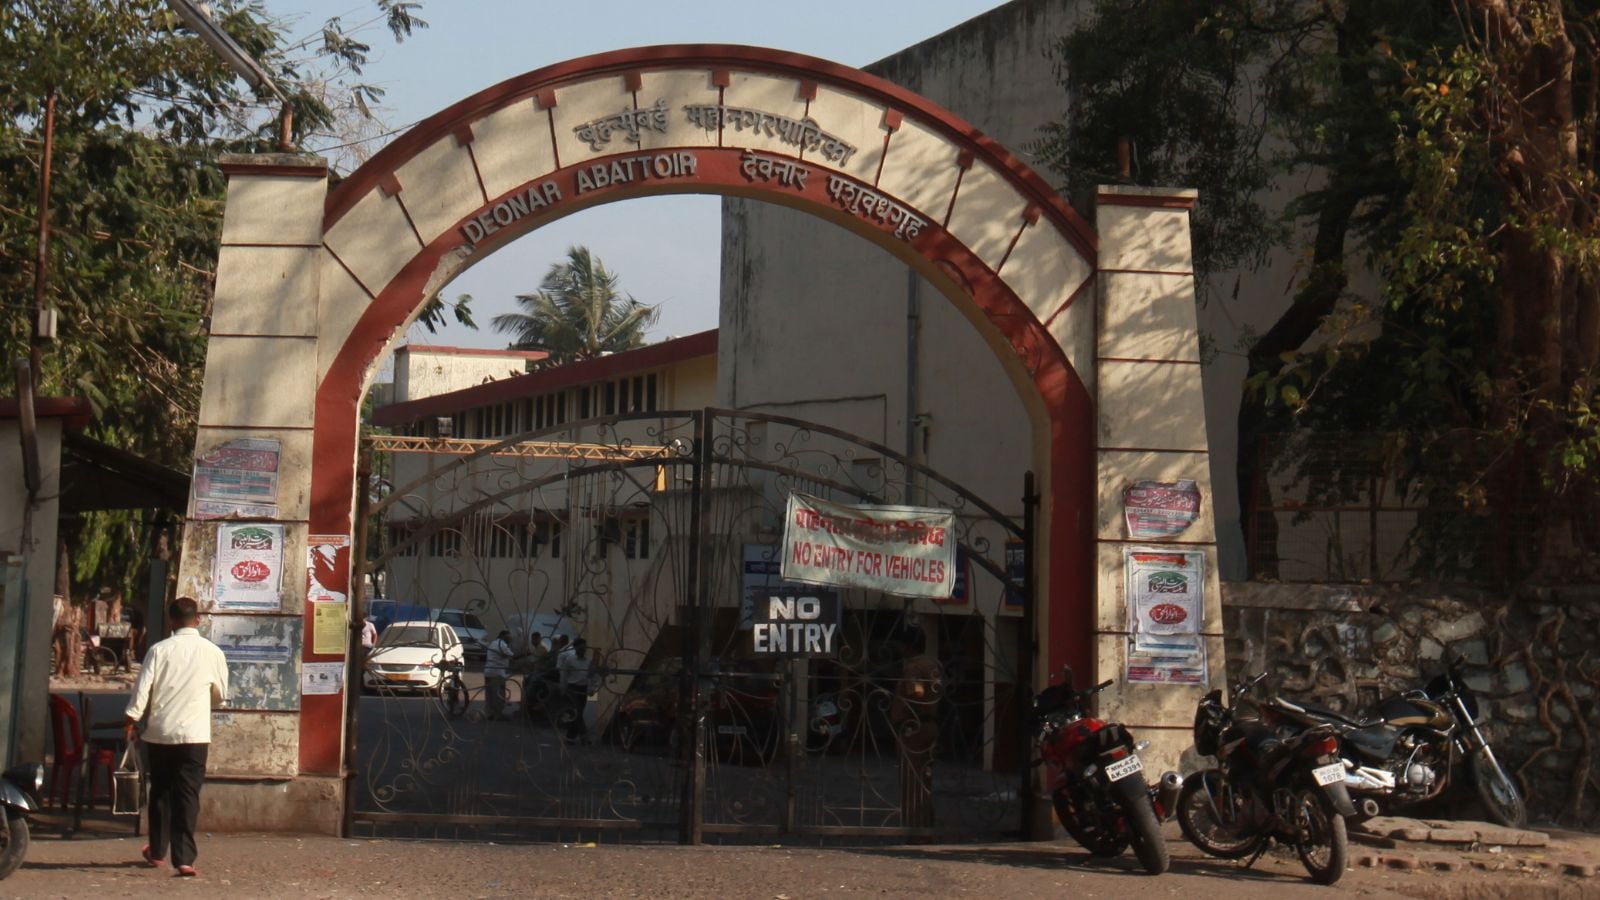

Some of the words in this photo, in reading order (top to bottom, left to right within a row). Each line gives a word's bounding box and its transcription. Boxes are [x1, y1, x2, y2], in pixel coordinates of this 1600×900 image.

[683, 103, 858, 166] महानगरपालिका
[462, 180, 562, 245] DEONAR
[576, 152, 697, 195] ABATTOIR
[740, 149, 810, 189] देवनार
[827, 173, 928, 241] पशुवधगृह
[792, 541, 811, 566] NO
[814, 544, 853, 573] ENTRY
[856, 550, 882, 577] FOR
[885, 555, 945, 584] VEHICLES
[769, 596, 820, 620] NO
[754, 623, 836, 653] ENTRY
